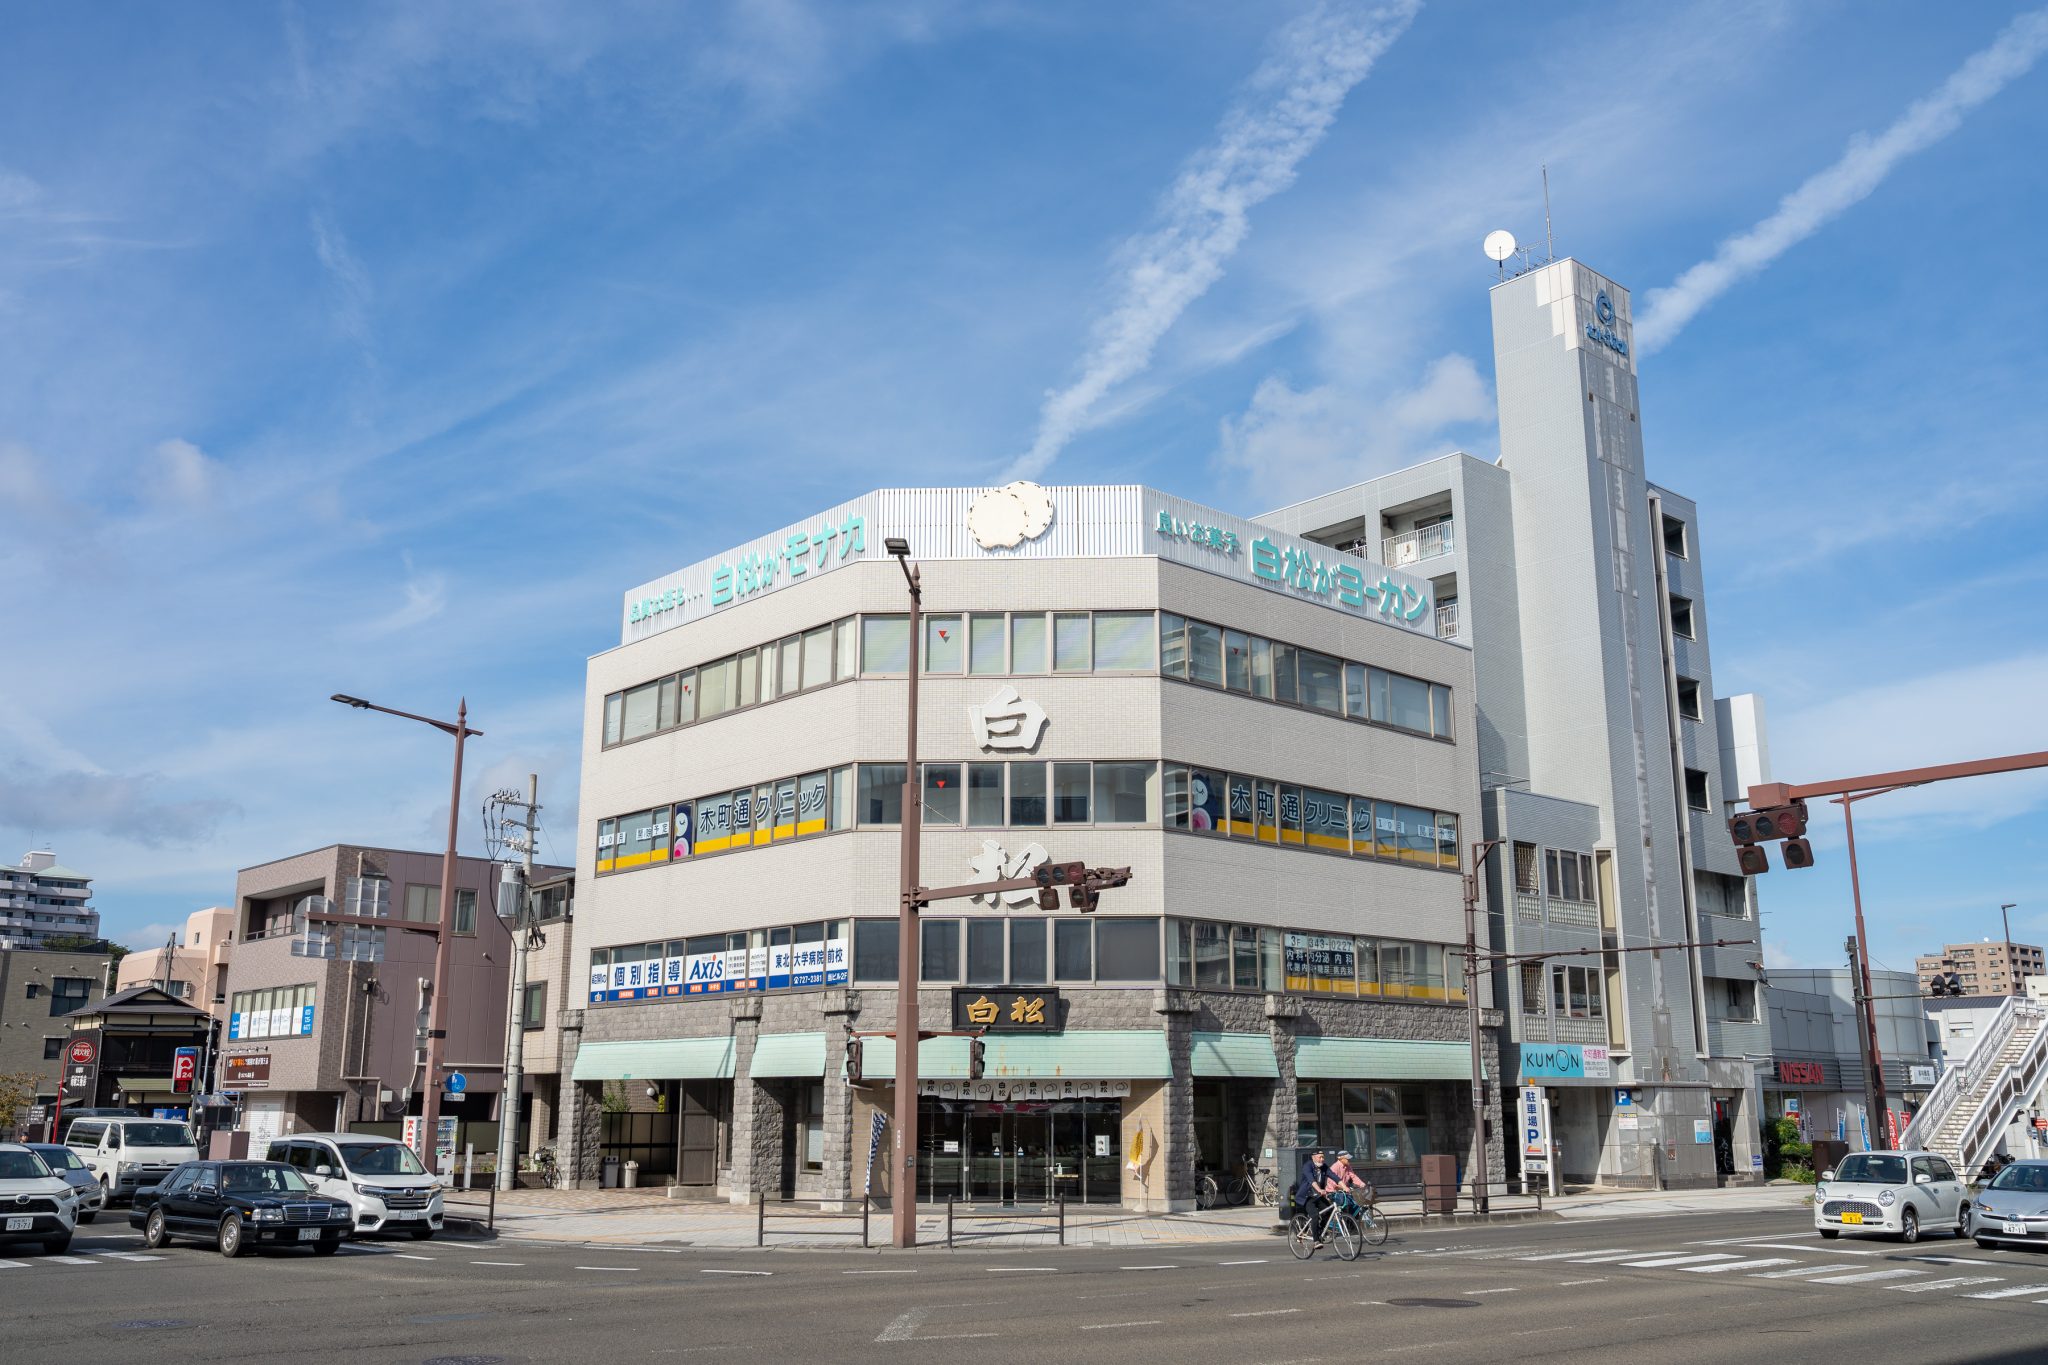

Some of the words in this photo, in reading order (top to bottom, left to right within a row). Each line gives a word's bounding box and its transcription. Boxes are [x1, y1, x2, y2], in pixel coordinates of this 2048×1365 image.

[712, 513, 866, 606] 白松がモナカ
[1156, 510, 1238, 553] 良いお菓子
[1250, 536, 1427, 621] 白松がヨーカン
[699, 783, 827, 833] 木町通クリニック
[1231, 785, 1371, 832] 木町通クリニック
[614, 960, 681, 987] 個別指導
[775, 947, 843, 968] 東北大学病院前校
[966, 995, 1045, 1023] 白松
[1526, 1049, 1579, 1072] KUMON
[1780, 1061, 1824, 1085] NISSAN
[1525, 1091, 1538, 1127] 駐車場
